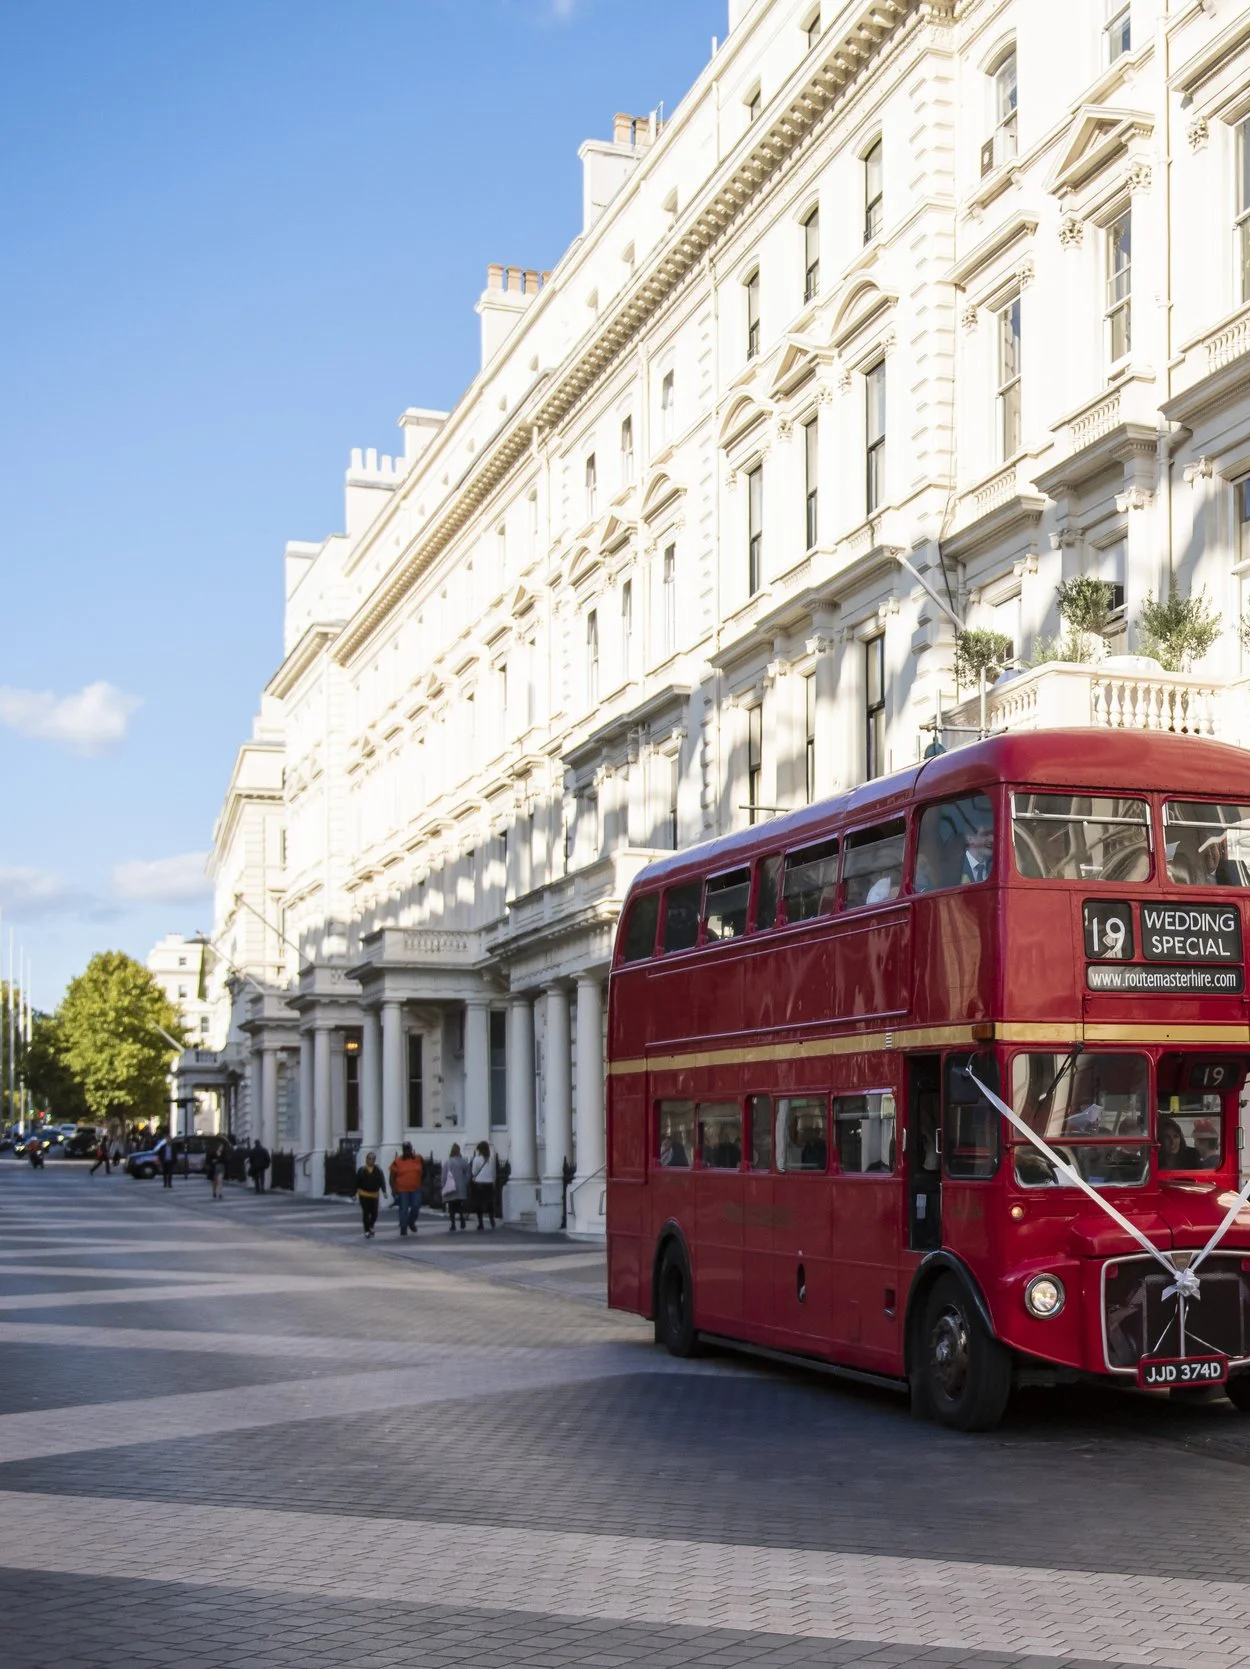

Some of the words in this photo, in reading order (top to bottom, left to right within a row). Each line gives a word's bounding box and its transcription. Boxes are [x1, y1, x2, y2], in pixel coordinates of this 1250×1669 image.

[1144, 909, 1235, 932] WEDDING
[1092, 917, 1126, 955] 19
[1152, 936, 1231, 956] SPECIAL
[1091, 969, 1236, 988] www.routemasterhire.com
[1203, 1067, 1225, 1086] 19
[1146, 1365, 1177, 1382] JJD
[1180, 1362, 1221, 1380] 374D
